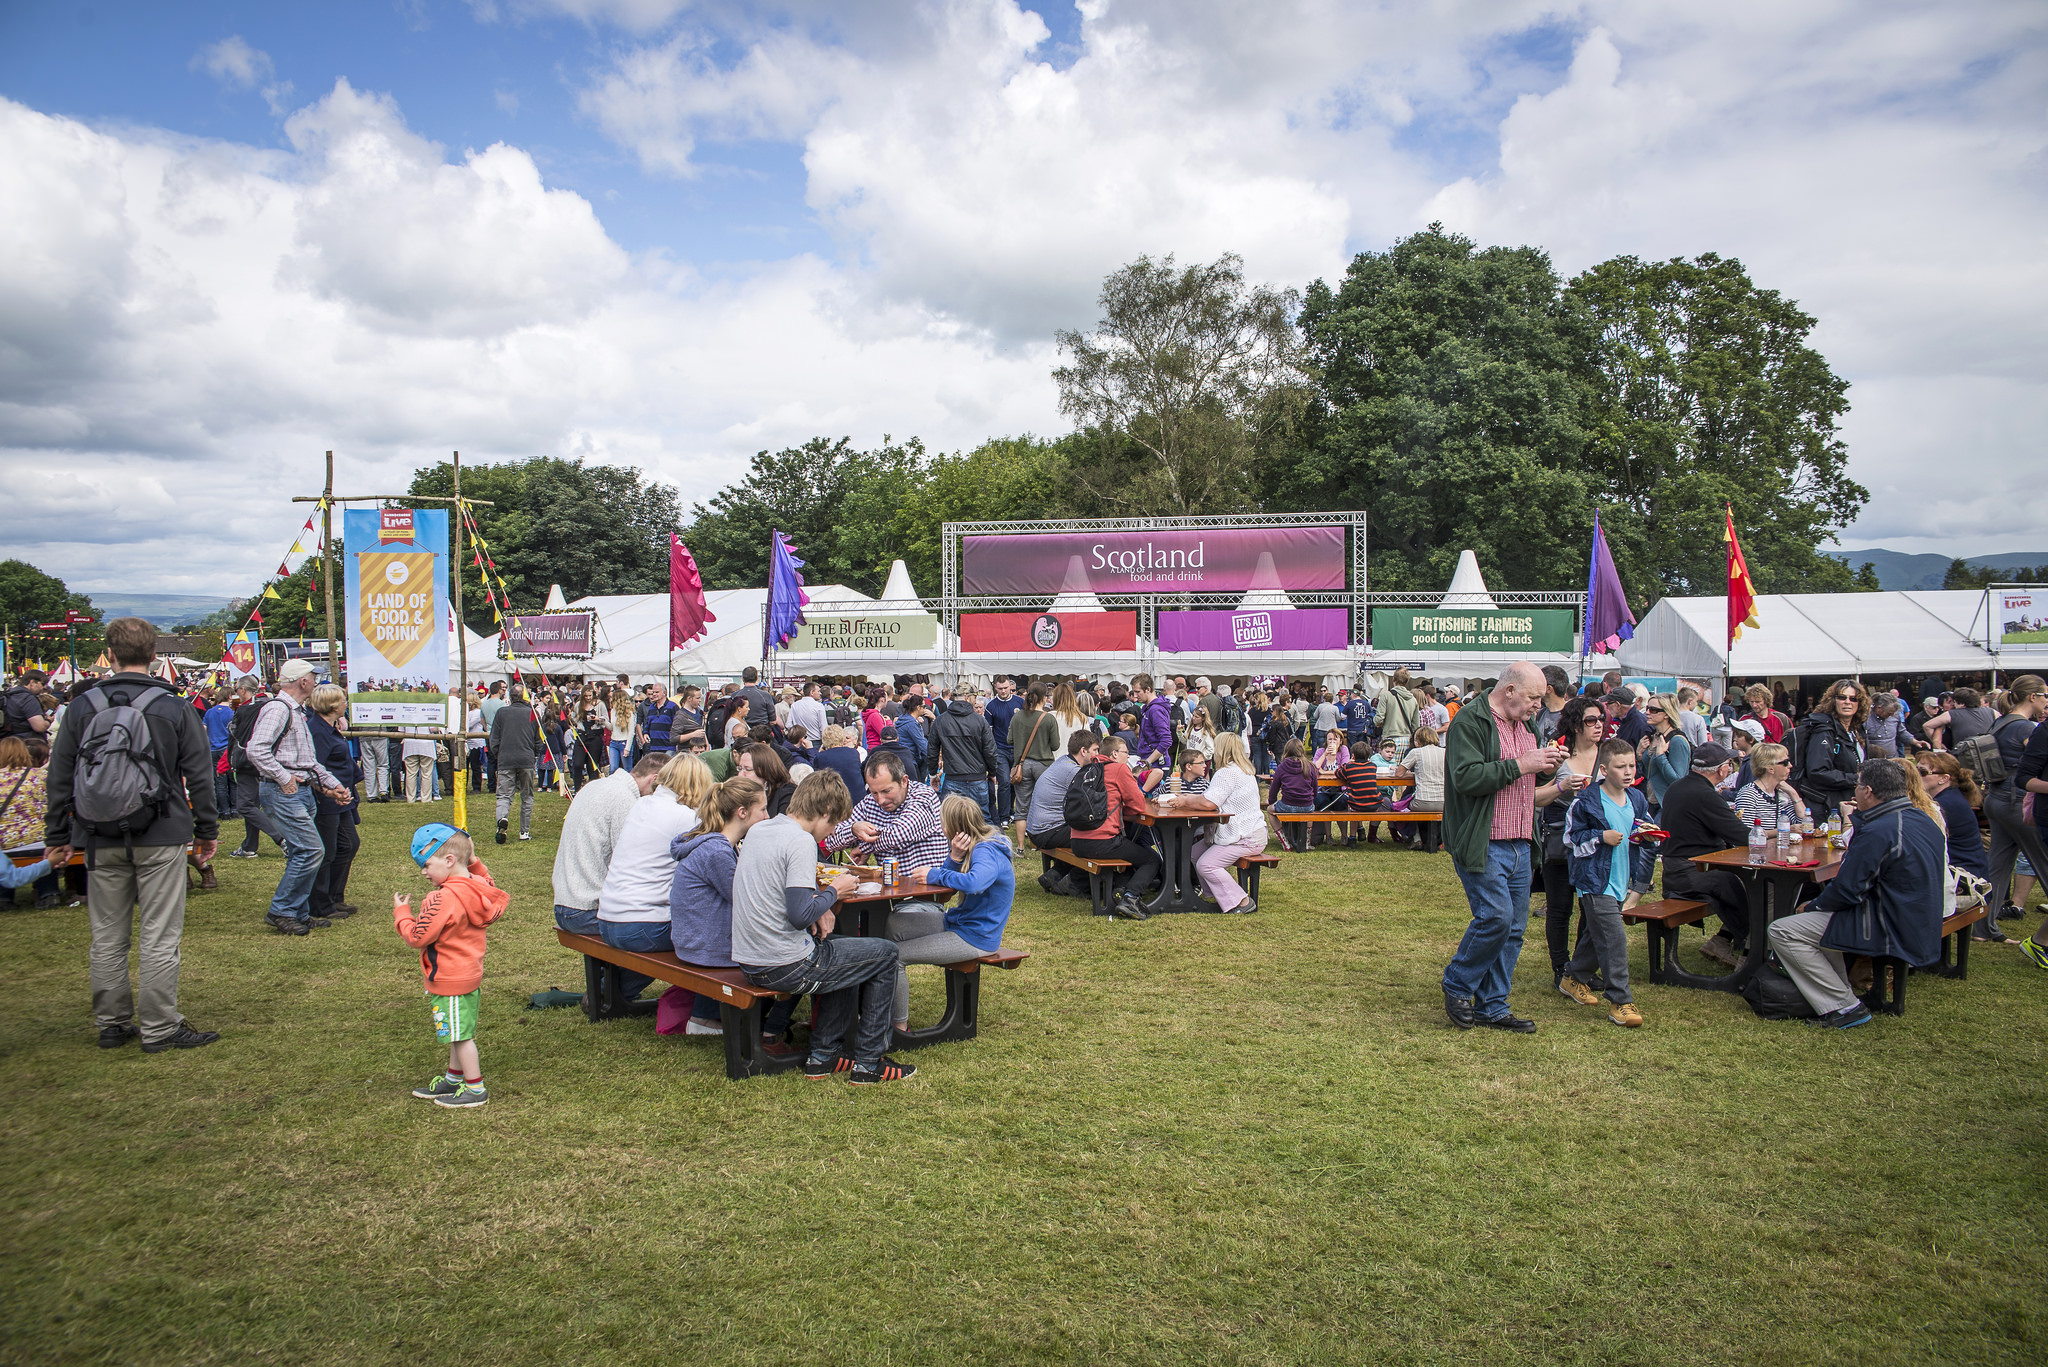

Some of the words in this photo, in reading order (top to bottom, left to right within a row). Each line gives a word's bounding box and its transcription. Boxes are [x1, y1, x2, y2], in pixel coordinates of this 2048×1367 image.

[1091, 541, 1204, 570] Scotland
[1130, 571, 1153, 582] food
[1156, 571, 1174, 581] and
[1177, 570, 1204, 581] drink
[367, 593, 405, 608] LAND
[409, 593, 427, 608] OF
[2005, 600, 2031, 609] Live
[371, 609, 409, 625] FOOD
[413, 610, 424, 625] &
[1236, 618, 1251, 628] IT'S
[1252, 616, 1267, 627] ALL
[1412, 616, 1477, 632] PERTHSHIRE
[1481, 616, 1533, 632] FARMERS
[376, 625, 420, 641] DRINK
[509, 627, 533, 640] Scottish
[534, 627, 560, 640] Farmers
[561, 627, 585, 640] Market
[809, 623, 836, 635] THE
[839, 618, 901, 635] BUFFALO
[1237, 626, 1268, 641] FOOD!
[815, 637, 852, 649] FARM
[854, 636, 895, 648] GRILL
[1412, 634, 1437, 646] good
[1439, 632, 1463, 644] food
[1465, 633, 1475, 644] in
[1478, 633, 1499, 644] safe
[1502, 633, 1533, 645] hands
[234, 648, 254, 663] 14
[1353, 705, 1366, 719] 14
